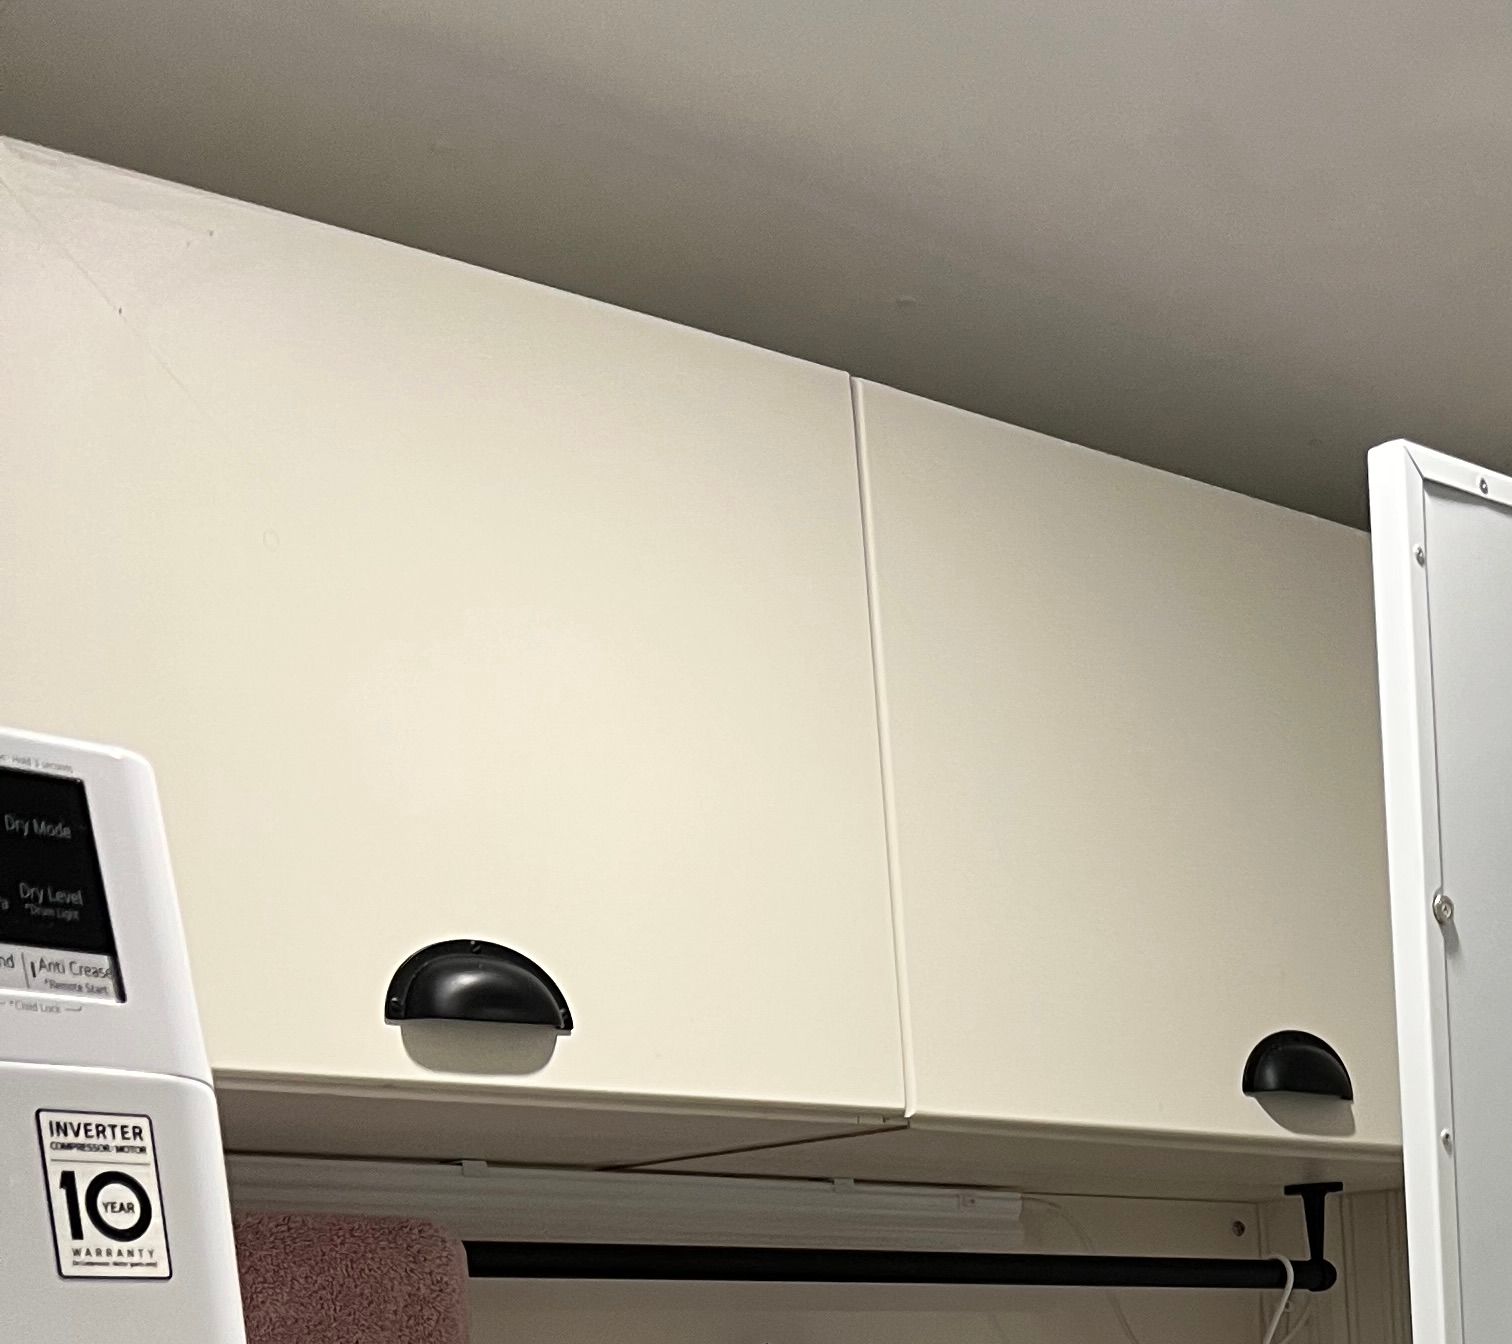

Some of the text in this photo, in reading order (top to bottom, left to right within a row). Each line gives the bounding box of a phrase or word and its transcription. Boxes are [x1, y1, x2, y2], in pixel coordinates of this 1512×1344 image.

[4, 814, 71, 839] Dry Mode
[19, 882, 83, 906] Dry Level
[39, 957, 113, 980] Anti Crease
[49, 1120, 144, 1142] INVERTER
[50, 1141, 147, 1155] COMPRESSOR MOTOR
[59, 1170, 153, 1242] 10
[102, 1201, 135, 1214] YEAR
[72, 1248, 155, 1259] WARRANTY
